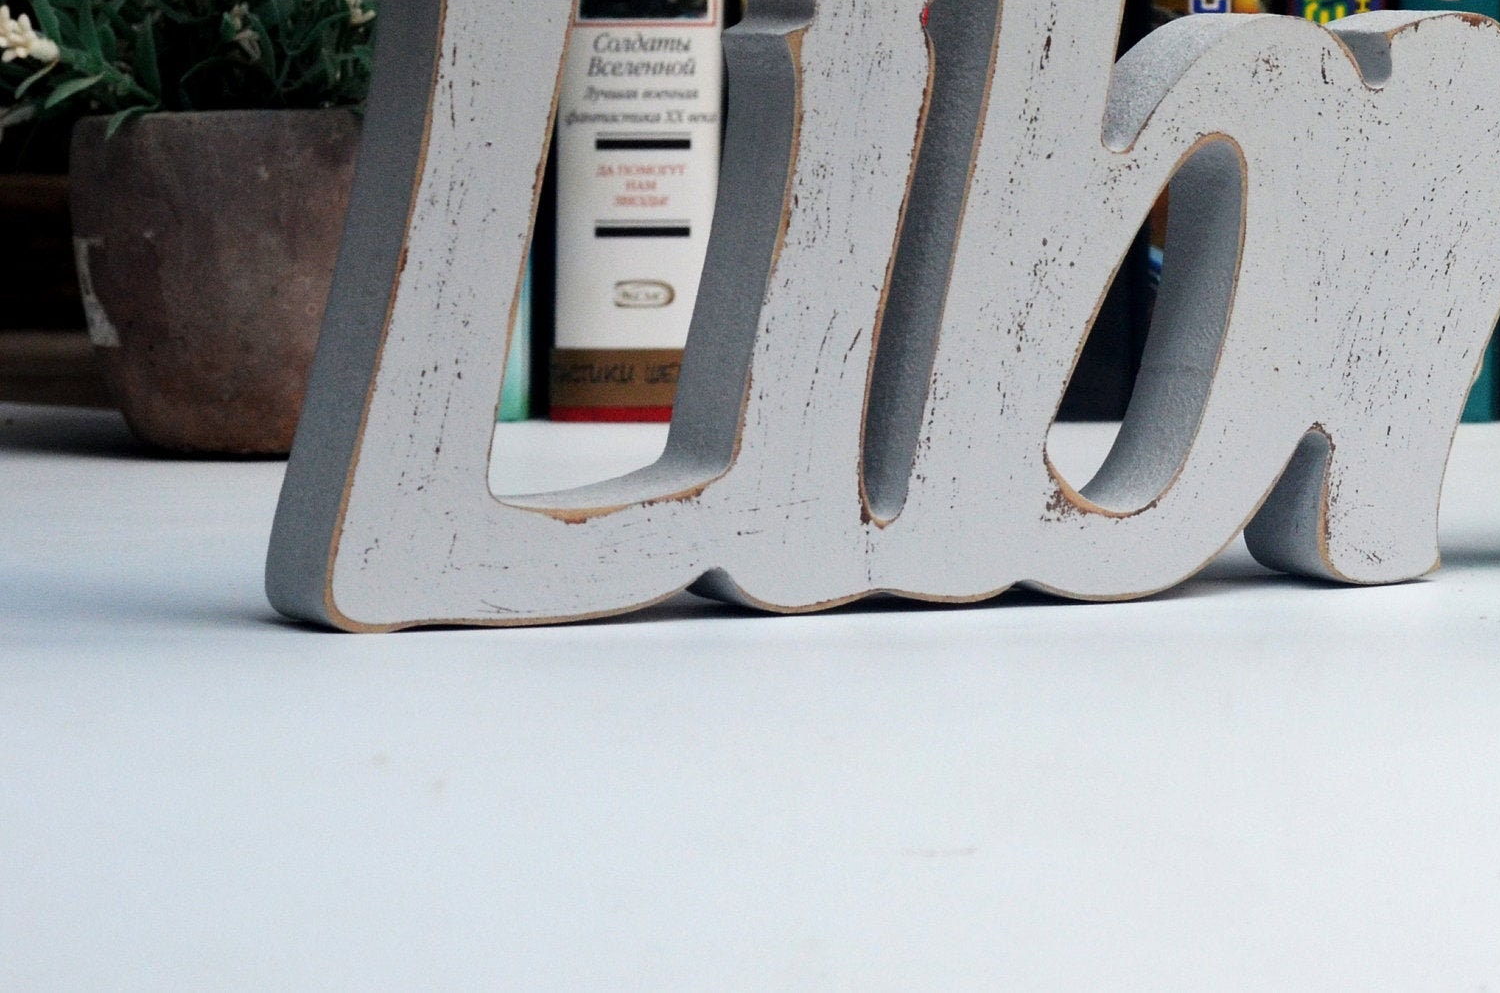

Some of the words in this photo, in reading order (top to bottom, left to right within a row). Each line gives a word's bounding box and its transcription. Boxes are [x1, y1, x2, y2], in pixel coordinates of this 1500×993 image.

[592, 32, 692, 56] Солдаты
[586, 56, 696, 79] Вселенной
[582, 85, 638, 103] Лучшая
[564, 107, 661, 127] фантастика
[625, 179, 658, 192] НАМ
